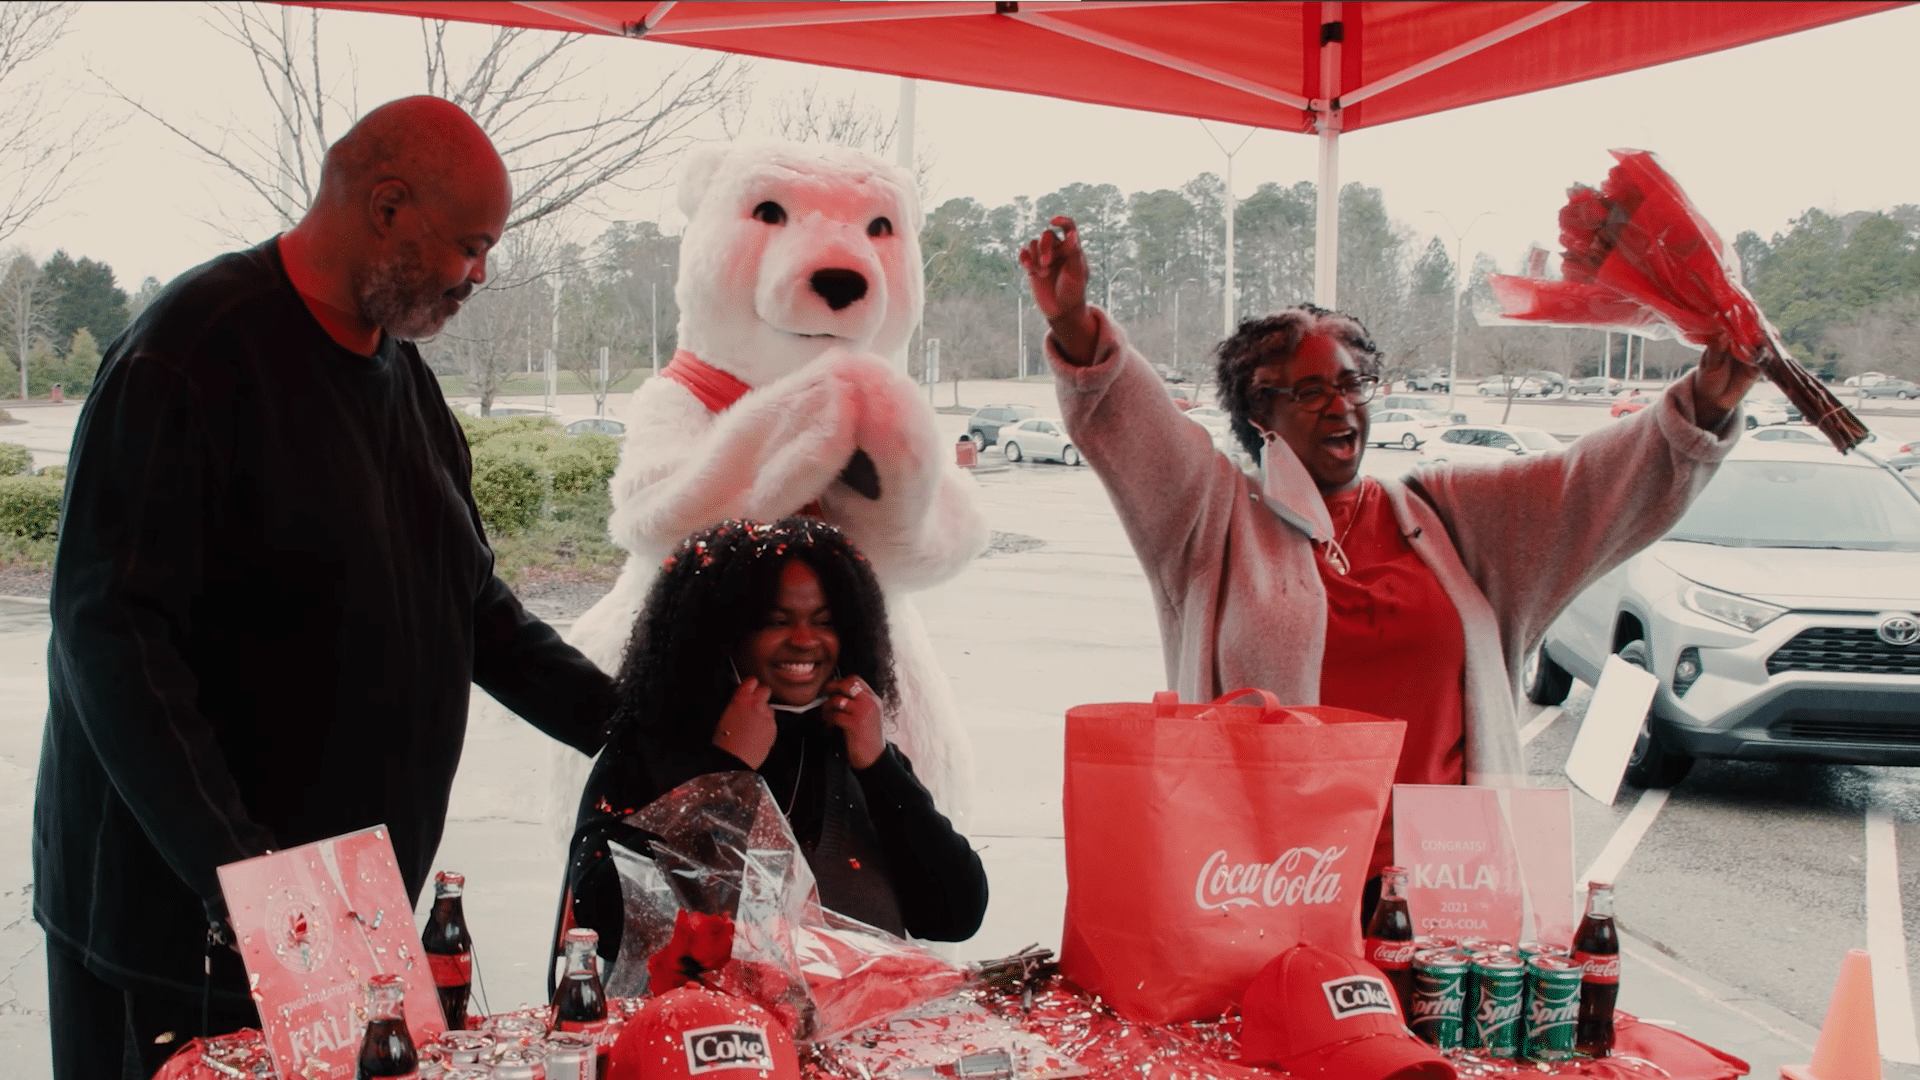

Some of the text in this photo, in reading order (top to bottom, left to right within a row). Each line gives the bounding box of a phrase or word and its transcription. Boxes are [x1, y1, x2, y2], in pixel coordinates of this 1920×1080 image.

[1195, 845, 1348, 910] Coca-Cola
[1414, 863, 1497, 890] KALA
[1440, 902, 1468, 913] 2021
[1421, 918, 1489, 930] COCA-COLA
[1335, 983, 1388, 1008] Coke
[696, 1034, 762, 1061] Coke
